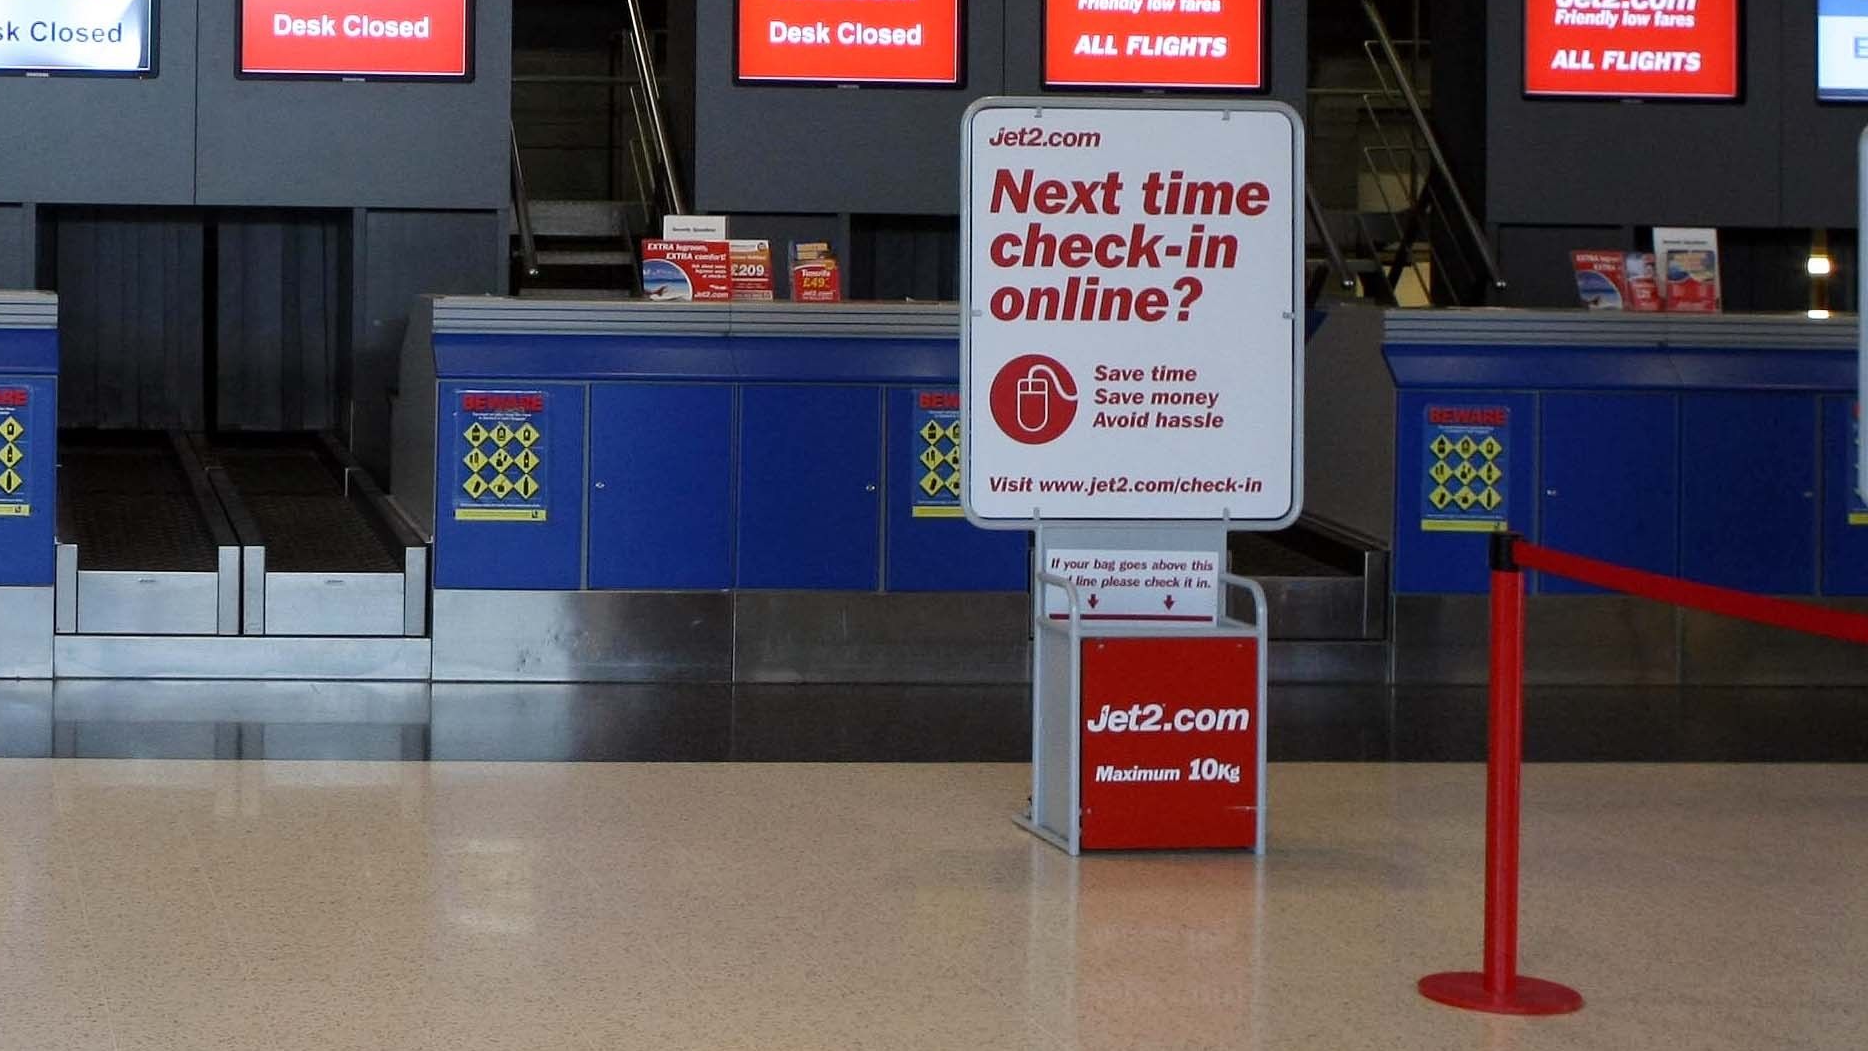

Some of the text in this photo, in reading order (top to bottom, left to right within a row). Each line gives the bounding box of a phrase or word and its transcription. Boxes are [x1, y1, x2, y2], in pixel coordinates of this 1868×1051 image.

[274, 14, 430, 39] Desk Closed
[1555, 8, 1695, 29] Friendly low fares
[30, 21, 122, 44] Closed
[769, 21, 923, 46] Desk Closed
[1074, 34, 1228, 58] ALL FLIGHTS
[1551, 50, 1701, 72] ALL FLIGHTS
[989, 127, 1101, 147] Jet2.com
[989, 169, 1270, 215] Next time
[989, 223, 1239, 269] check-in
[730, 264, 765, 277] £209
[989, 276, 1204, 322] online?
[1093, 365, 1197, 382] Save time
[463, 394, 544, 412] BEWARE
[1093, 389, 1220, 409] Save money
[1093, 412, 1225, 429] Avoid hassle
[1429, 406, 1507, 425] BEWARE
[989, 476, 1263, 496] Visit www.jet2.com/check-in
[1064, 559, 1089, 571] your
[1094, 559, 1116, 572] bag
[1119, 561, 1147, 572] goes
[1152, 559, 1187, 571] above
[1191, 560, 1213, 571] this
[1075, 576, 1098, 587] line
[1101, 576, 1140, 589] please
[1145, 576, 1180, 588] check
[1183, 577, 1192, 588] it
[1196, 578, 1211, 589] in.
[1087, 703, 1250, 733] Jet2.com
[1095, 757, 1240, 784] Maximum 10Kg
